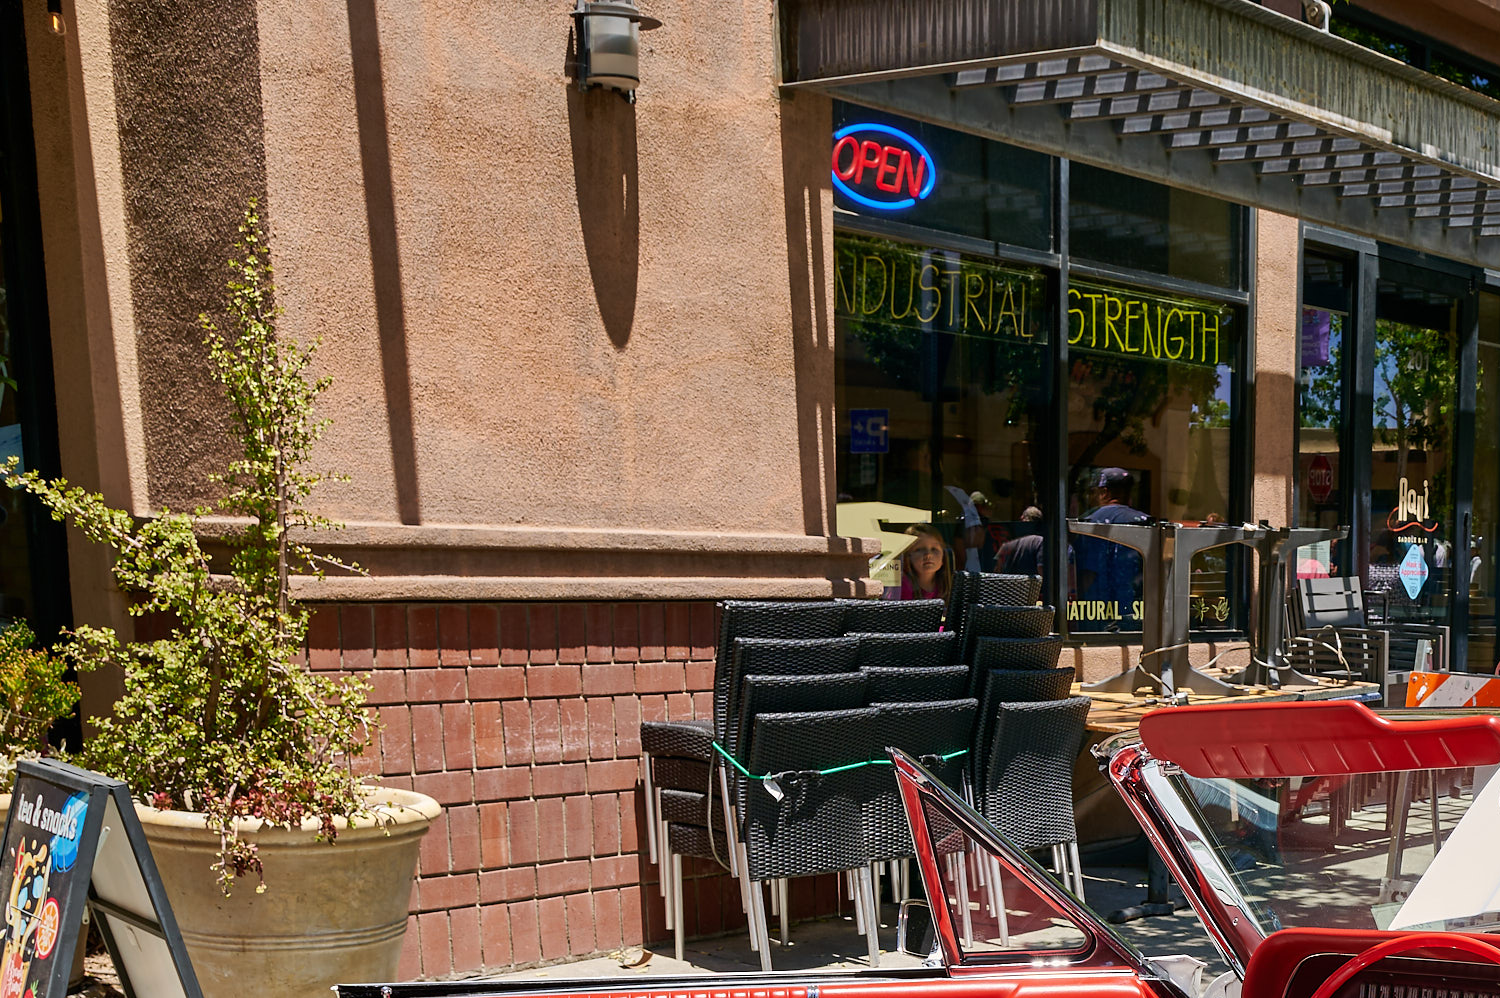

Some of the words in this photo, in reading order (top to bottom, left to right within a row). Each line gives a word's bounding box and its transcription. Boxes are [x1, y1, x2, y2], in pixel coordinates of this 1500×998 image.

[832, 136, 926, 198] OPEN
[835, 252, 1035, 339] NDUSTRIAL
[1068, 288, 1220, 365] STRENGTH
[1406, 351, 1429, 372] 201
[18, 793, 34, 825] tea
[32, 794, 43, 828] &
[41, 806, 78, 841] snacks
